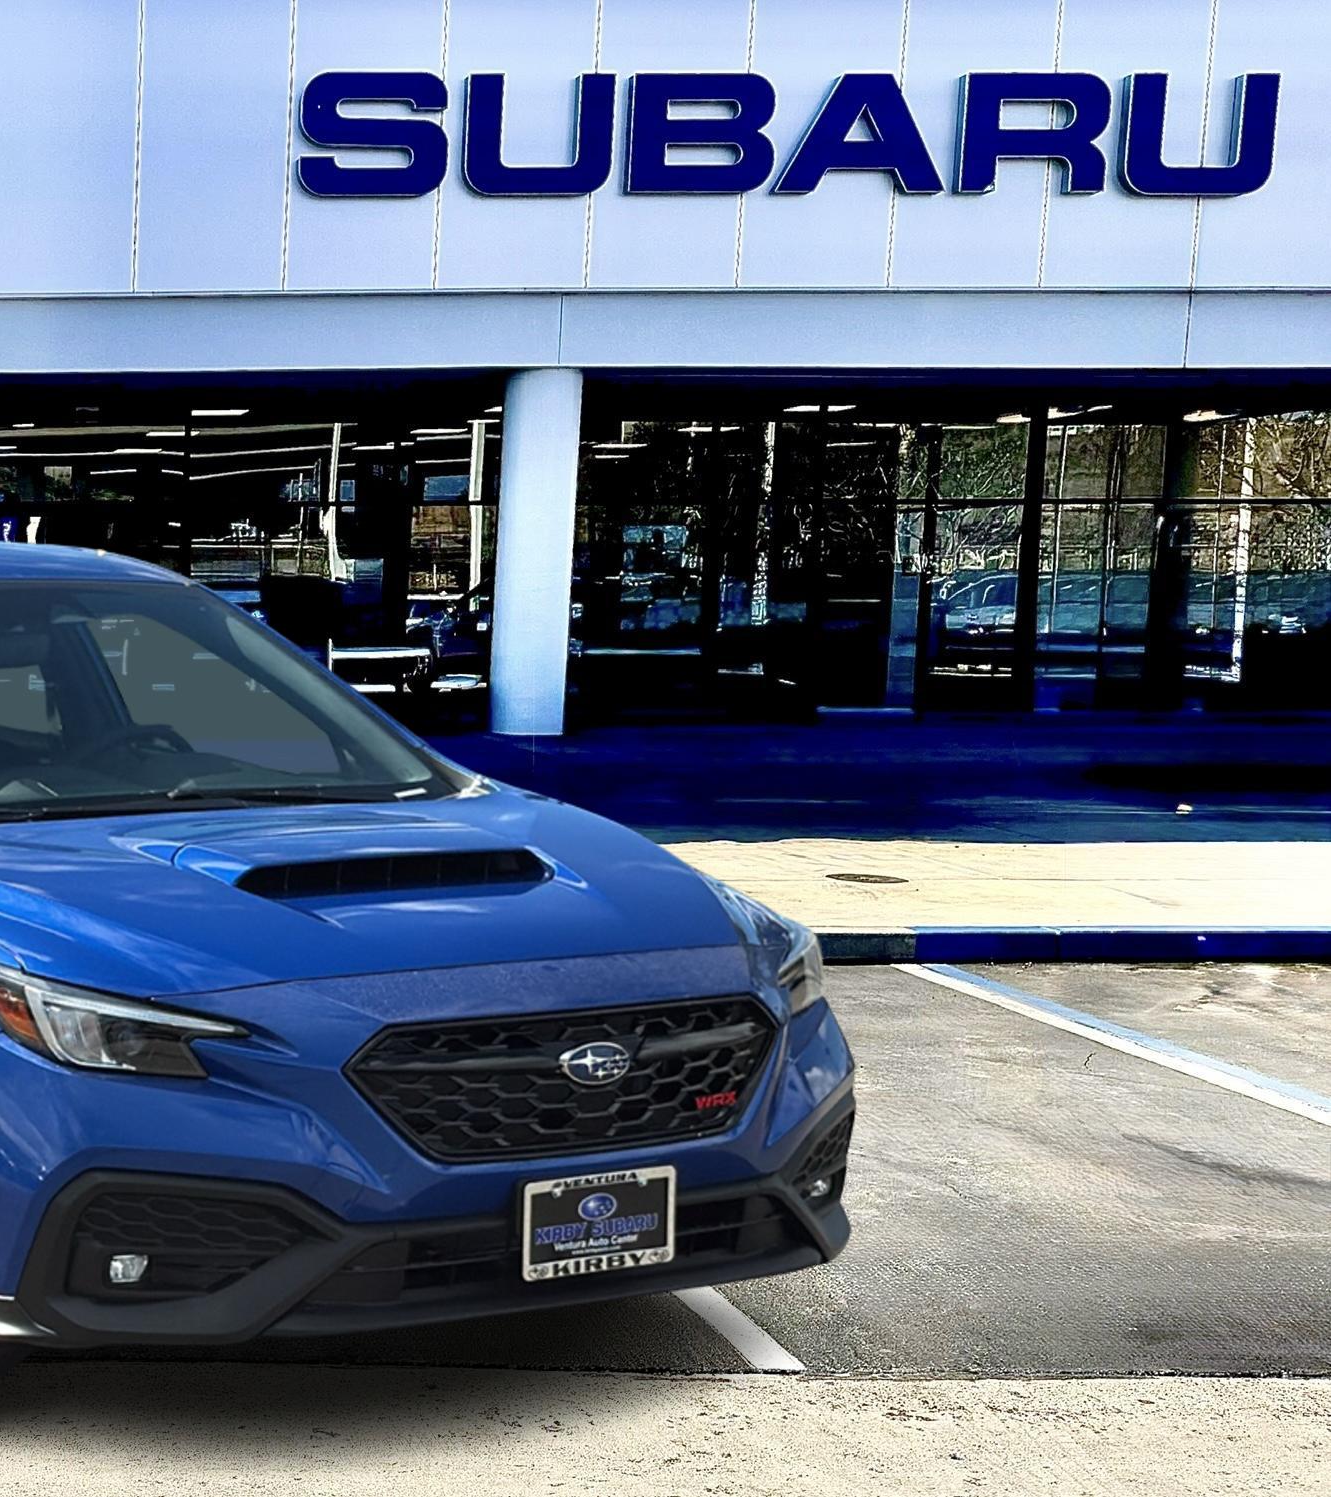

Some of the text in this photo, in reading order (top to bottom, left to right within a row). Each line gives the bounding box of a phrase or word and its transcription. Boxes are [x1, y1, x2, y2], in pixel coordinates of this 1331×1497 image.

[296, 71, 1282, 197] SUBARU
[695, 1091, 736, 1110] WRX
[563, 1172, 638, 1188] VENTURA
[535, 1214, 658, 1244] KIRBY SUBARU
[553, 1239, 587, 1252] Ventura
[588, 1236, 609, 1247] Auto
[610, 1233, 639, 1245] Center
[552, 1251, 646, 1276] KIRBY
